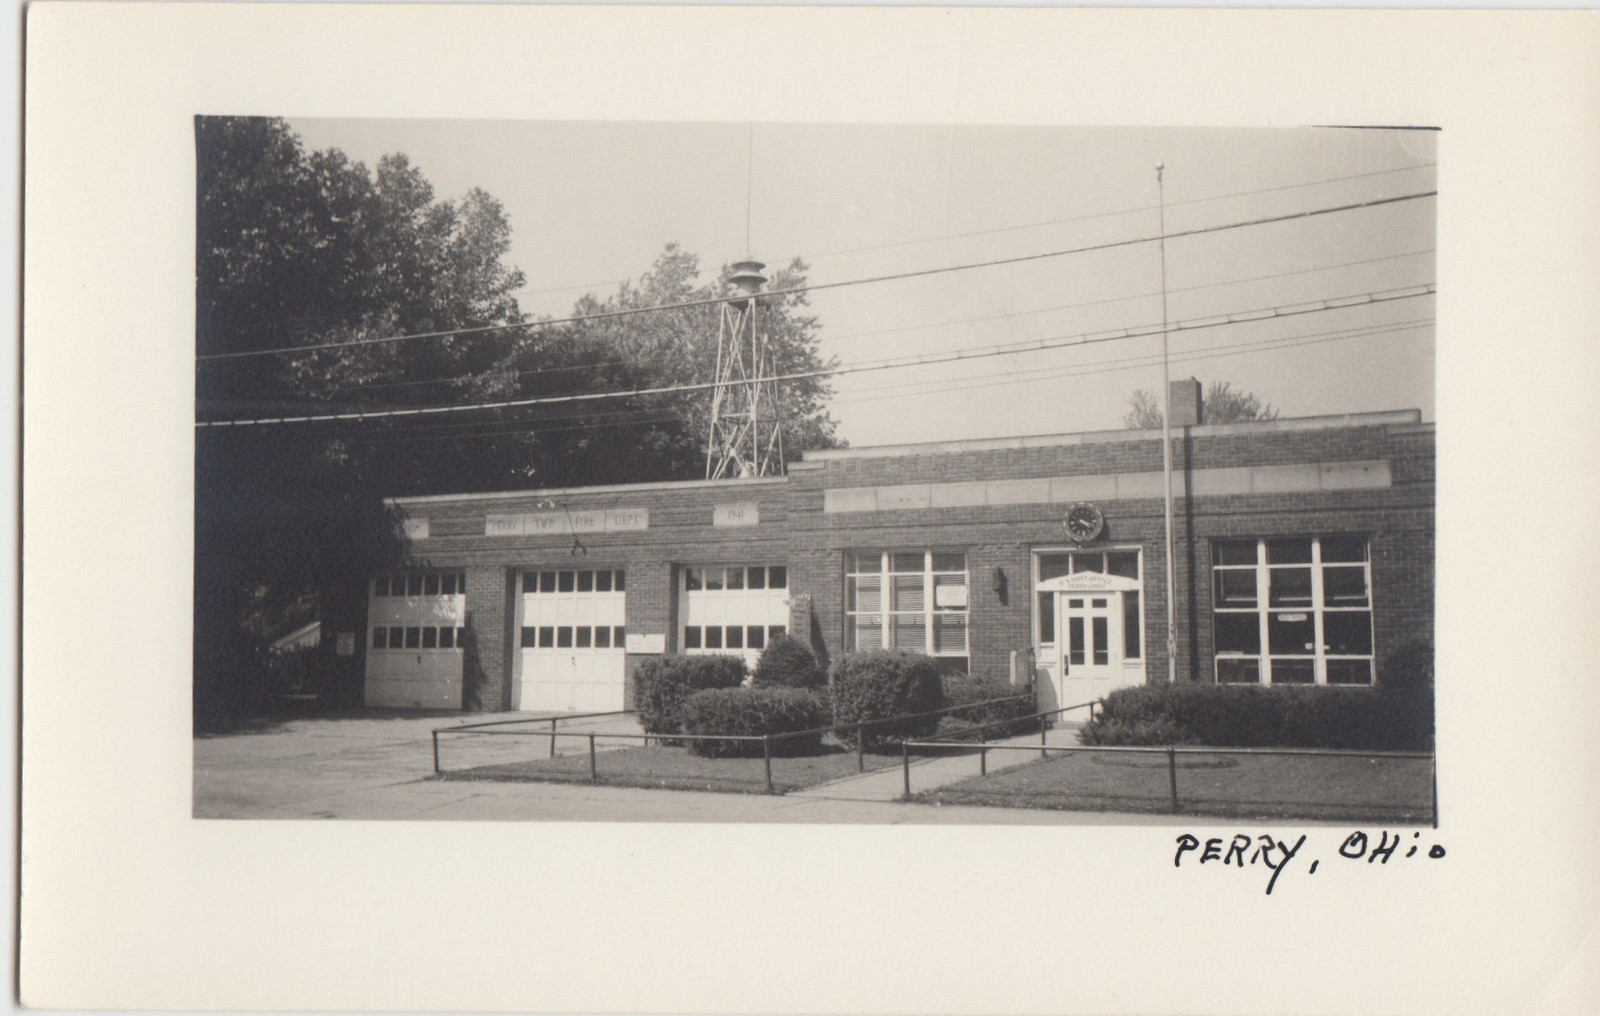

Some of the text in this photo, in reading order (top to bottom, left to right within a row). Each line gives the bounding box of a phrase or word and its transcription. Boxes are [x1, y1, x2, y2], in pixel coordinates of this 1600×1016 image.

[575, 515, 595, 528] FIRE
[1070, 575, 1088, 584] POST
[1088, 575, 1112, 586] OFFICE
